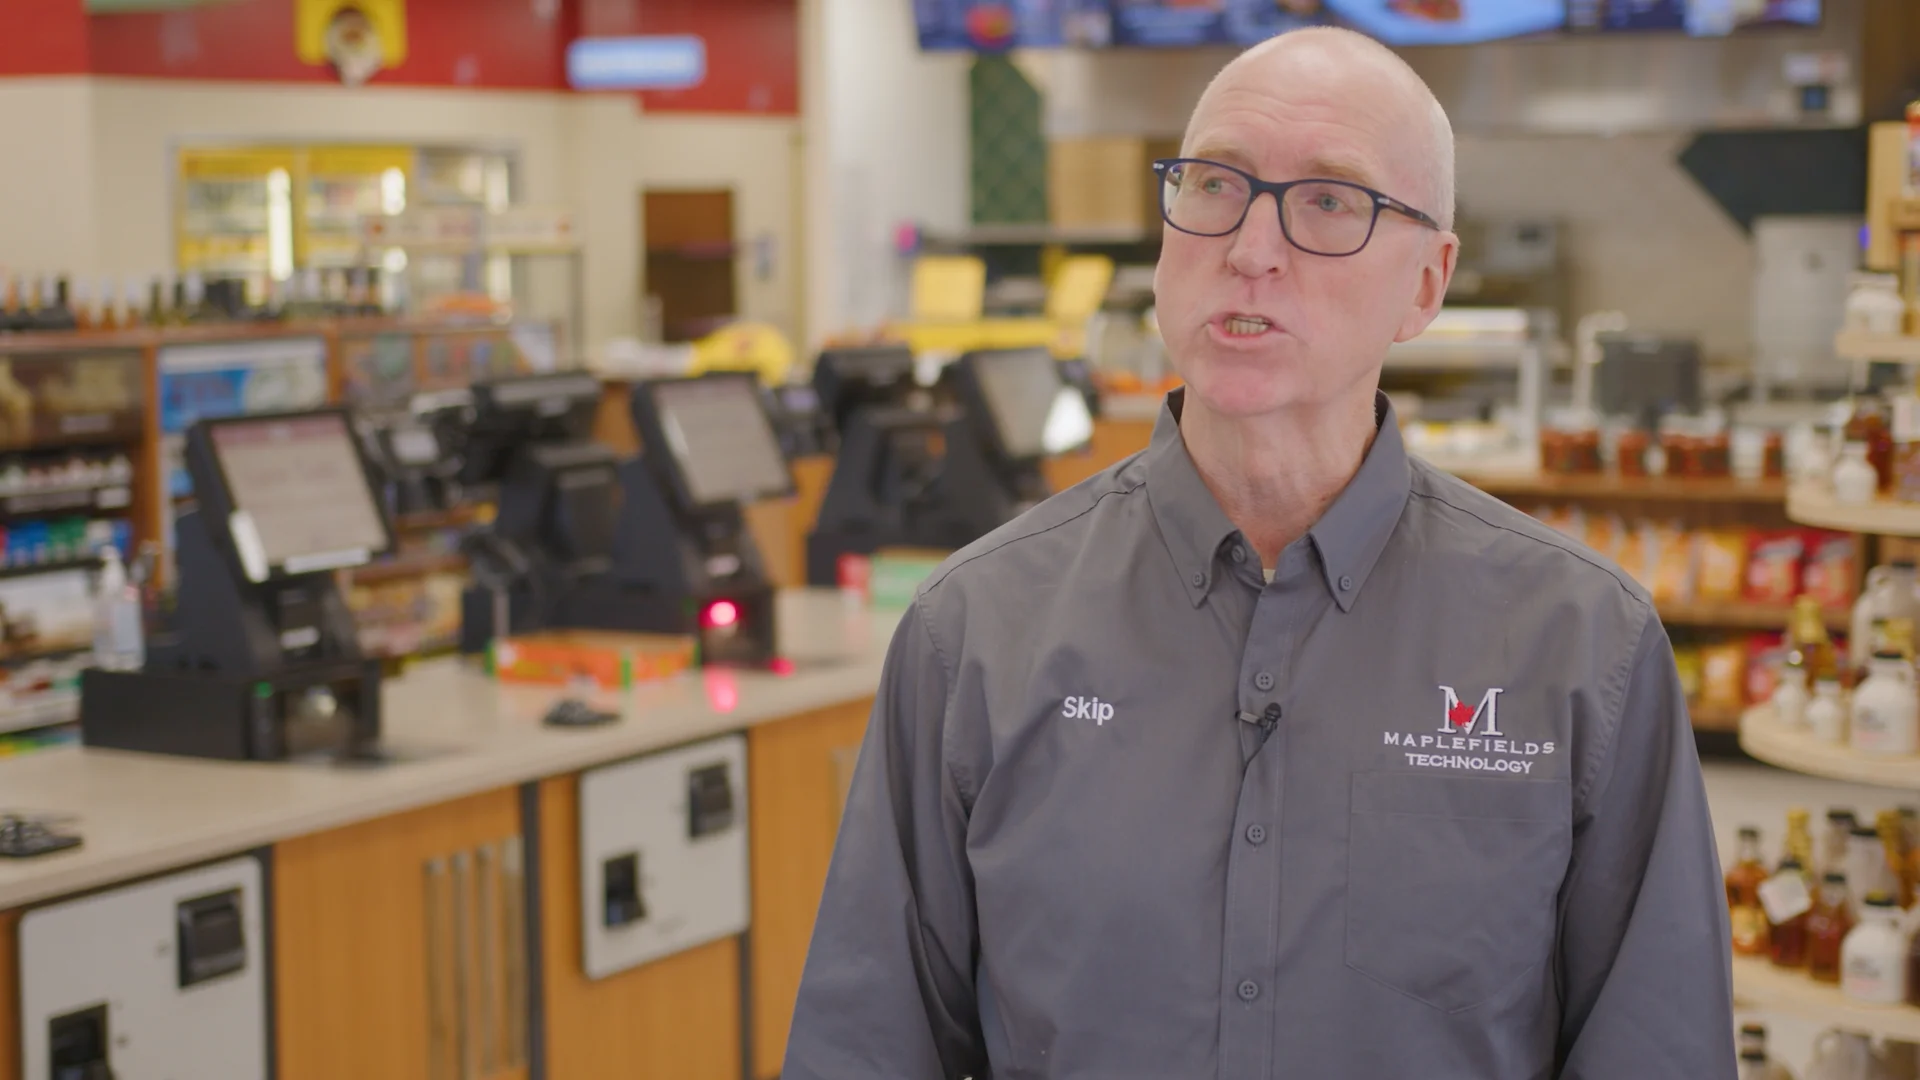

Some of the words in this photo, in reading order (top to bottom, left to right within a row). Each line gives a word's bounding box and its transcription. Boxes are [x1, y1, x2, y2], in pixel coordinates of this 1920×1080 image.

[1061, 695, 1115, 726] Skip
[1437, 685, 1504, 736] M
[1384, 731, 1556, 756] MAPLEFIELDS
[1404, 752, 1534, 775] TECHNOLOGY
